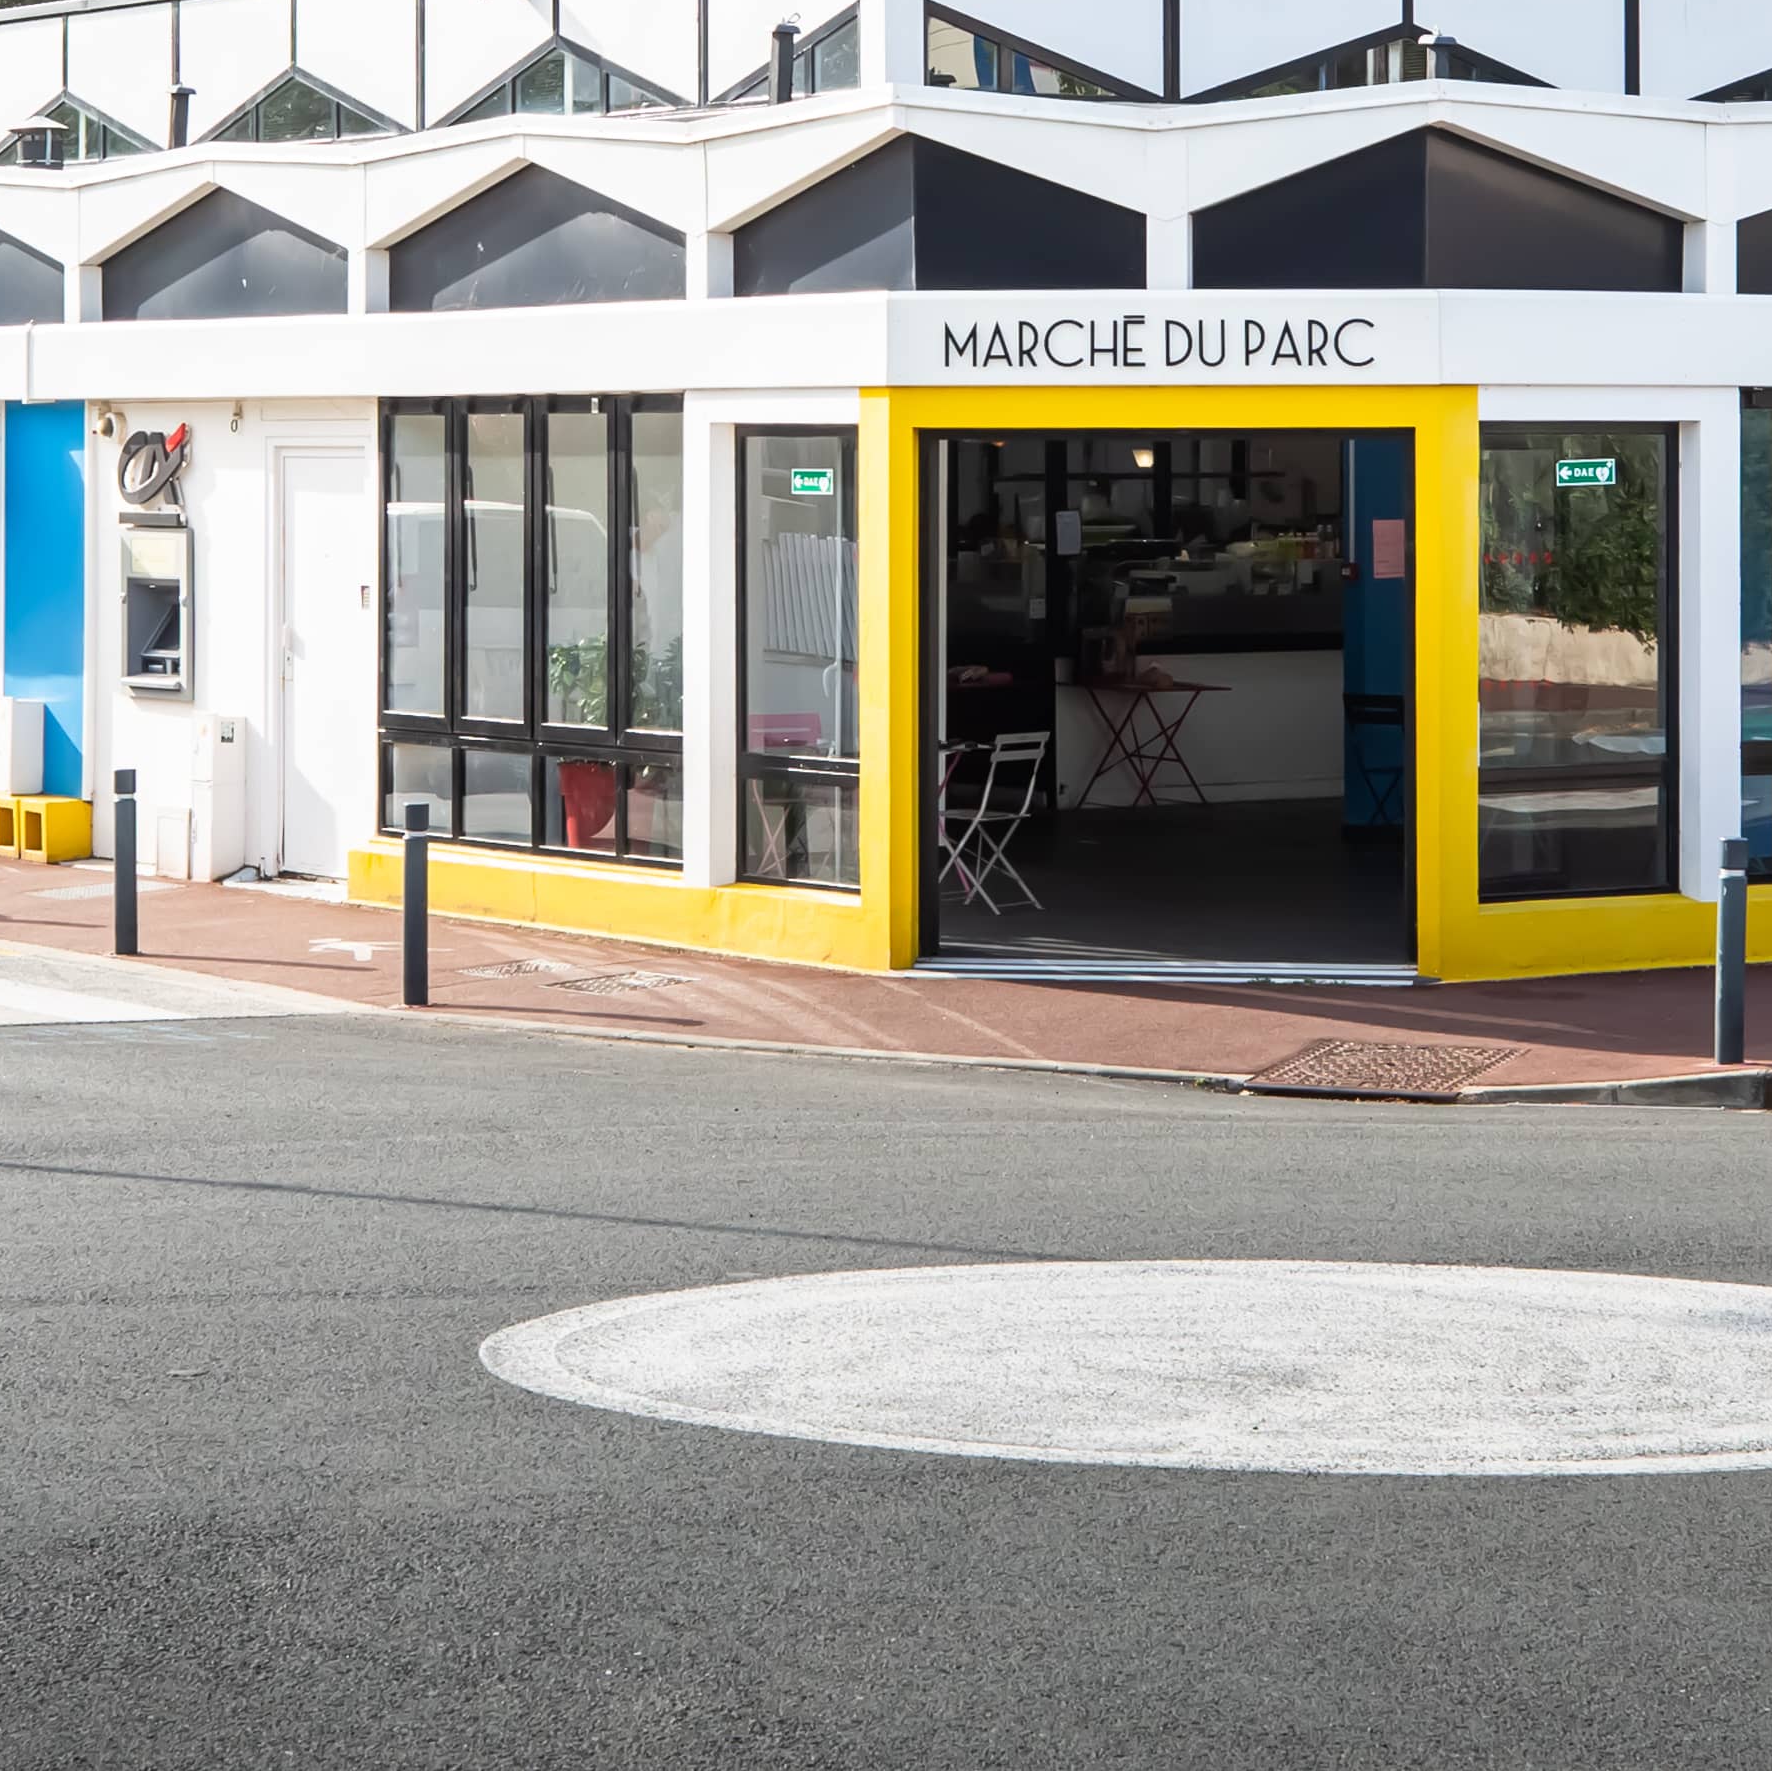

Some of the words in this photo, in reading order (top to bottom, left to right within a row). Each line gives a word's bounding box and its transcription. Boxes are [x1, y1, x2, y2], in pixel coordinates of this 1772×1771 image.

[1164, 319, 1227, 368] DU
[1243, 318, 1376, 368] PARC
[1573, 467, 1595, 478] DAE
